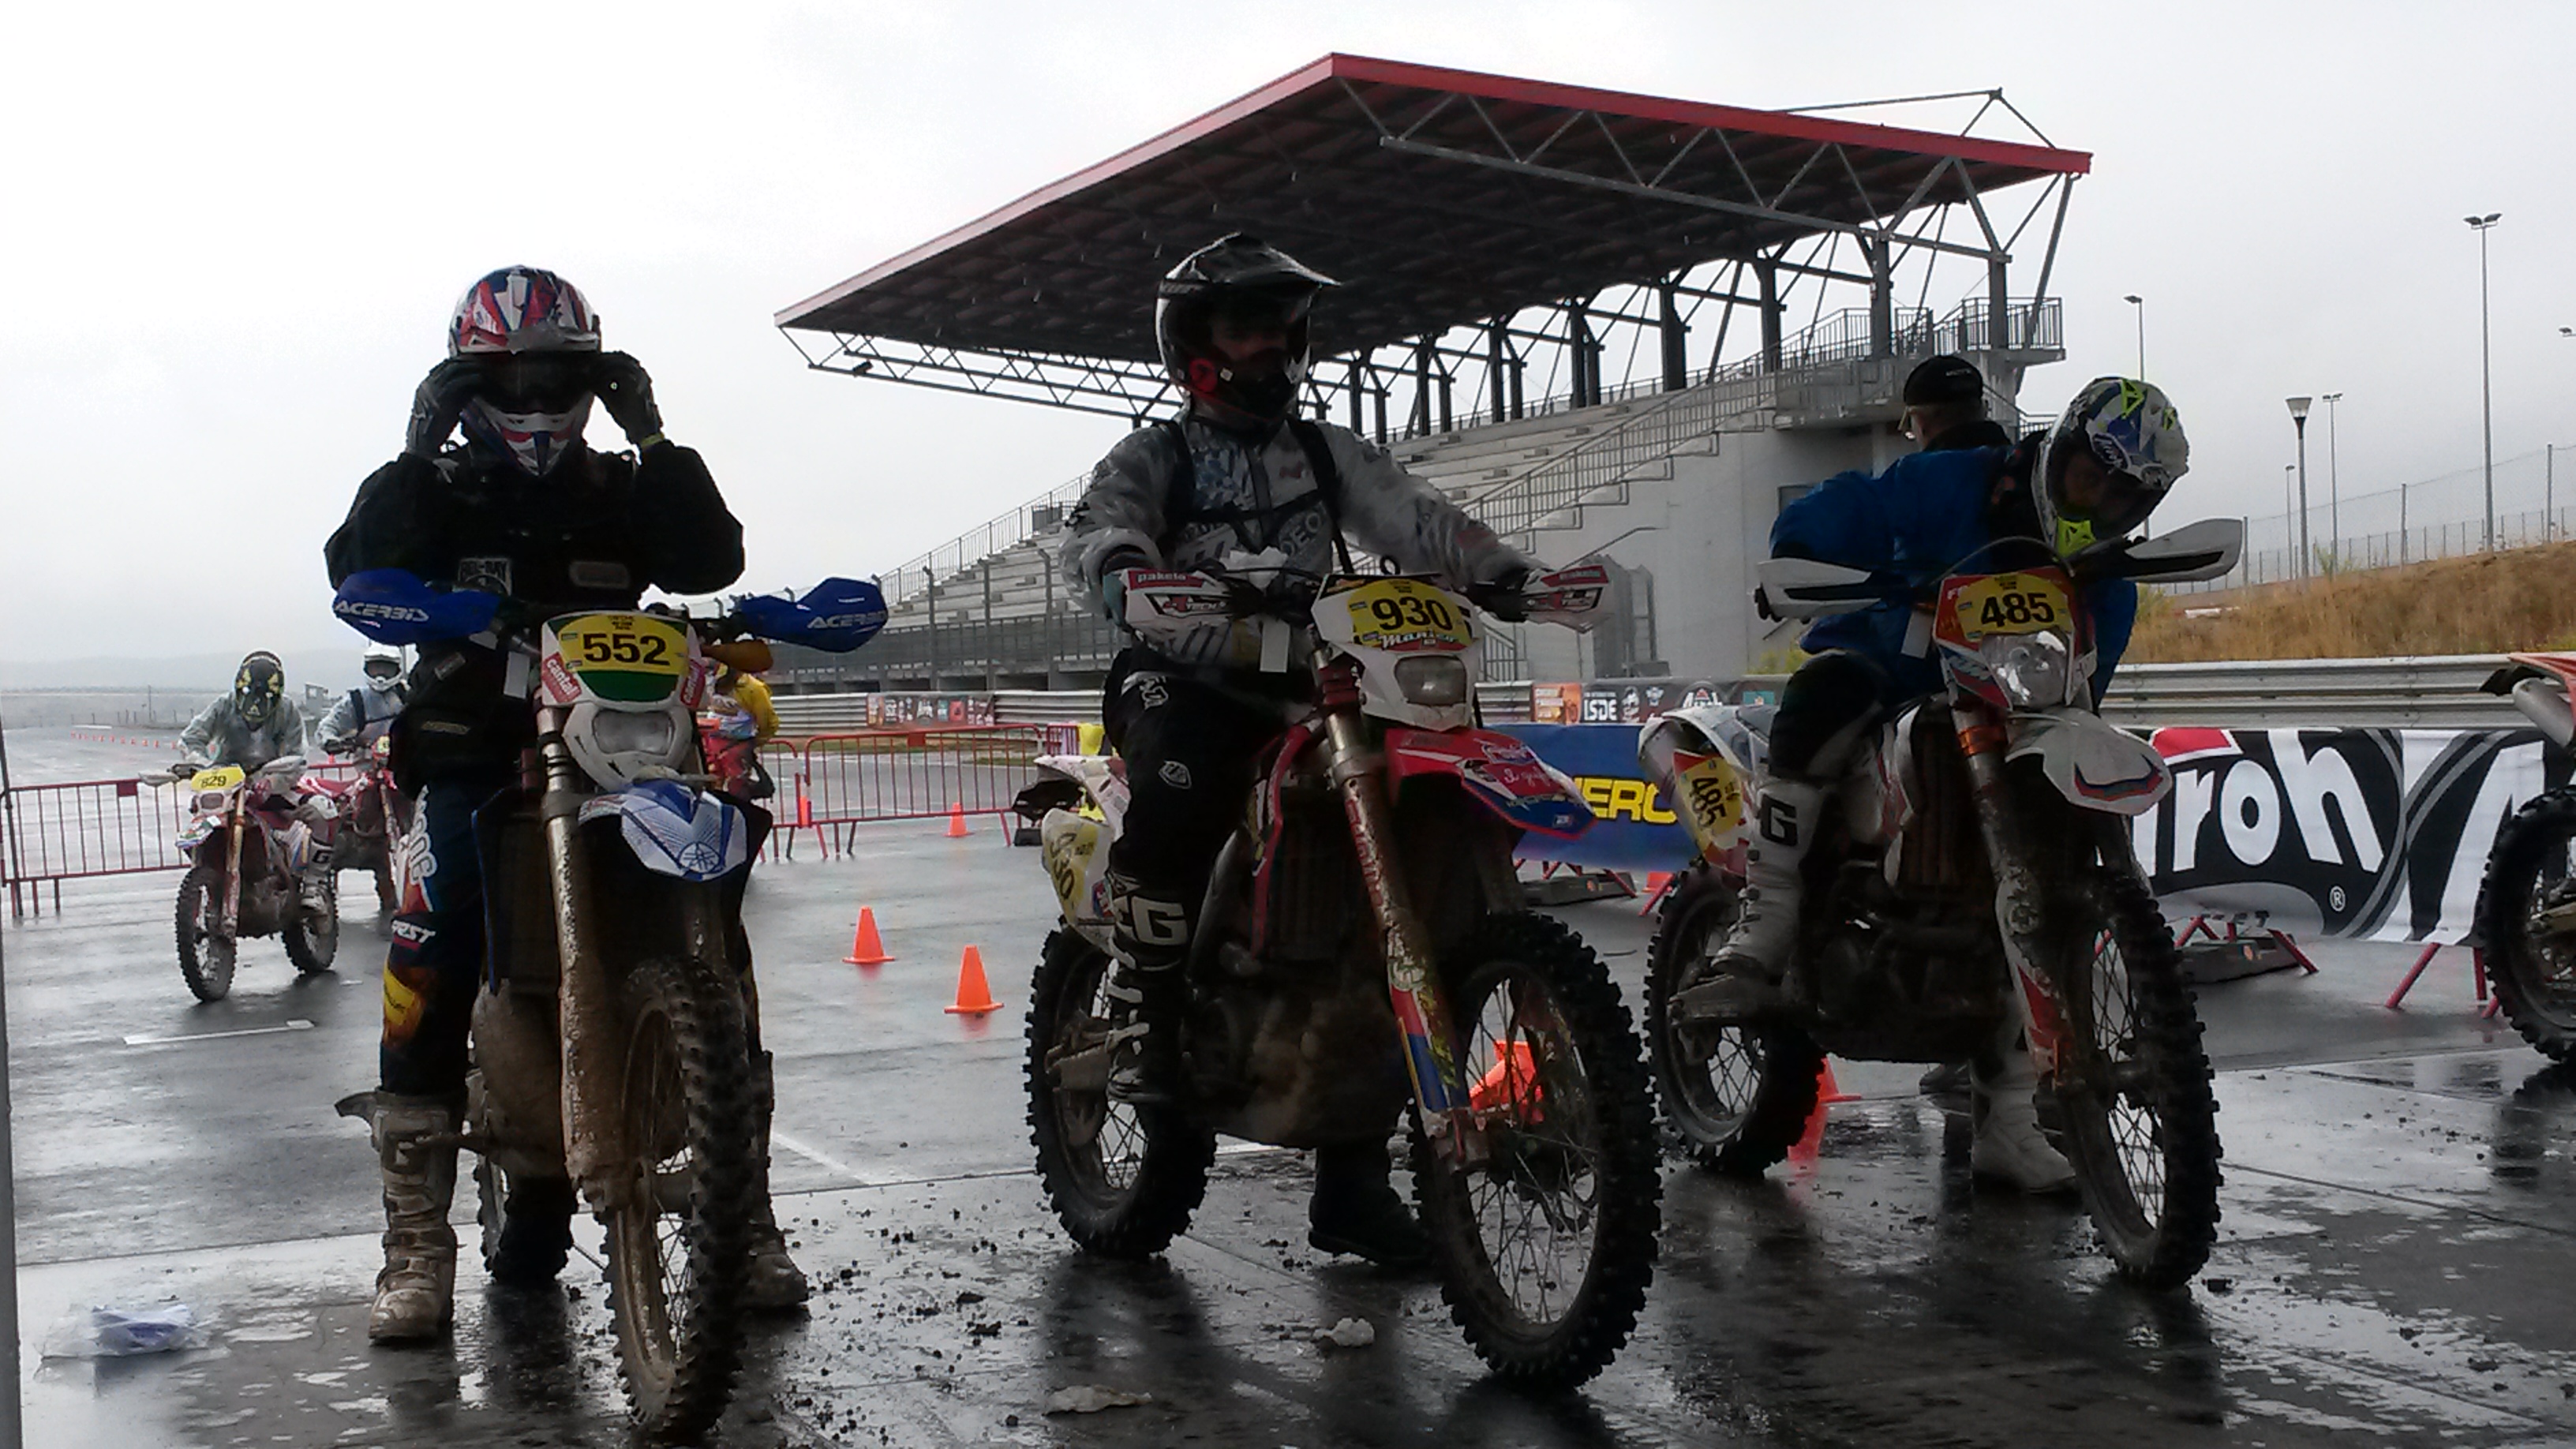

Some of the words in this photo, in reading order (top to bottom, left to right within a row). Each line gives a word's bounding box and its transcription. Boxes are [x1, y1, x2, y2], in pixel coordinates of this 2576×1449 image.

[334, 599, 430, 622] ACERBIS
[1371, 596, 1453, 631] 930
[1981, 593, 2054, 627] 485
[582, 633, 670, 666] 552
[200, 775, 227, 788] 829
[1690, 777, 1727, 828] 485
